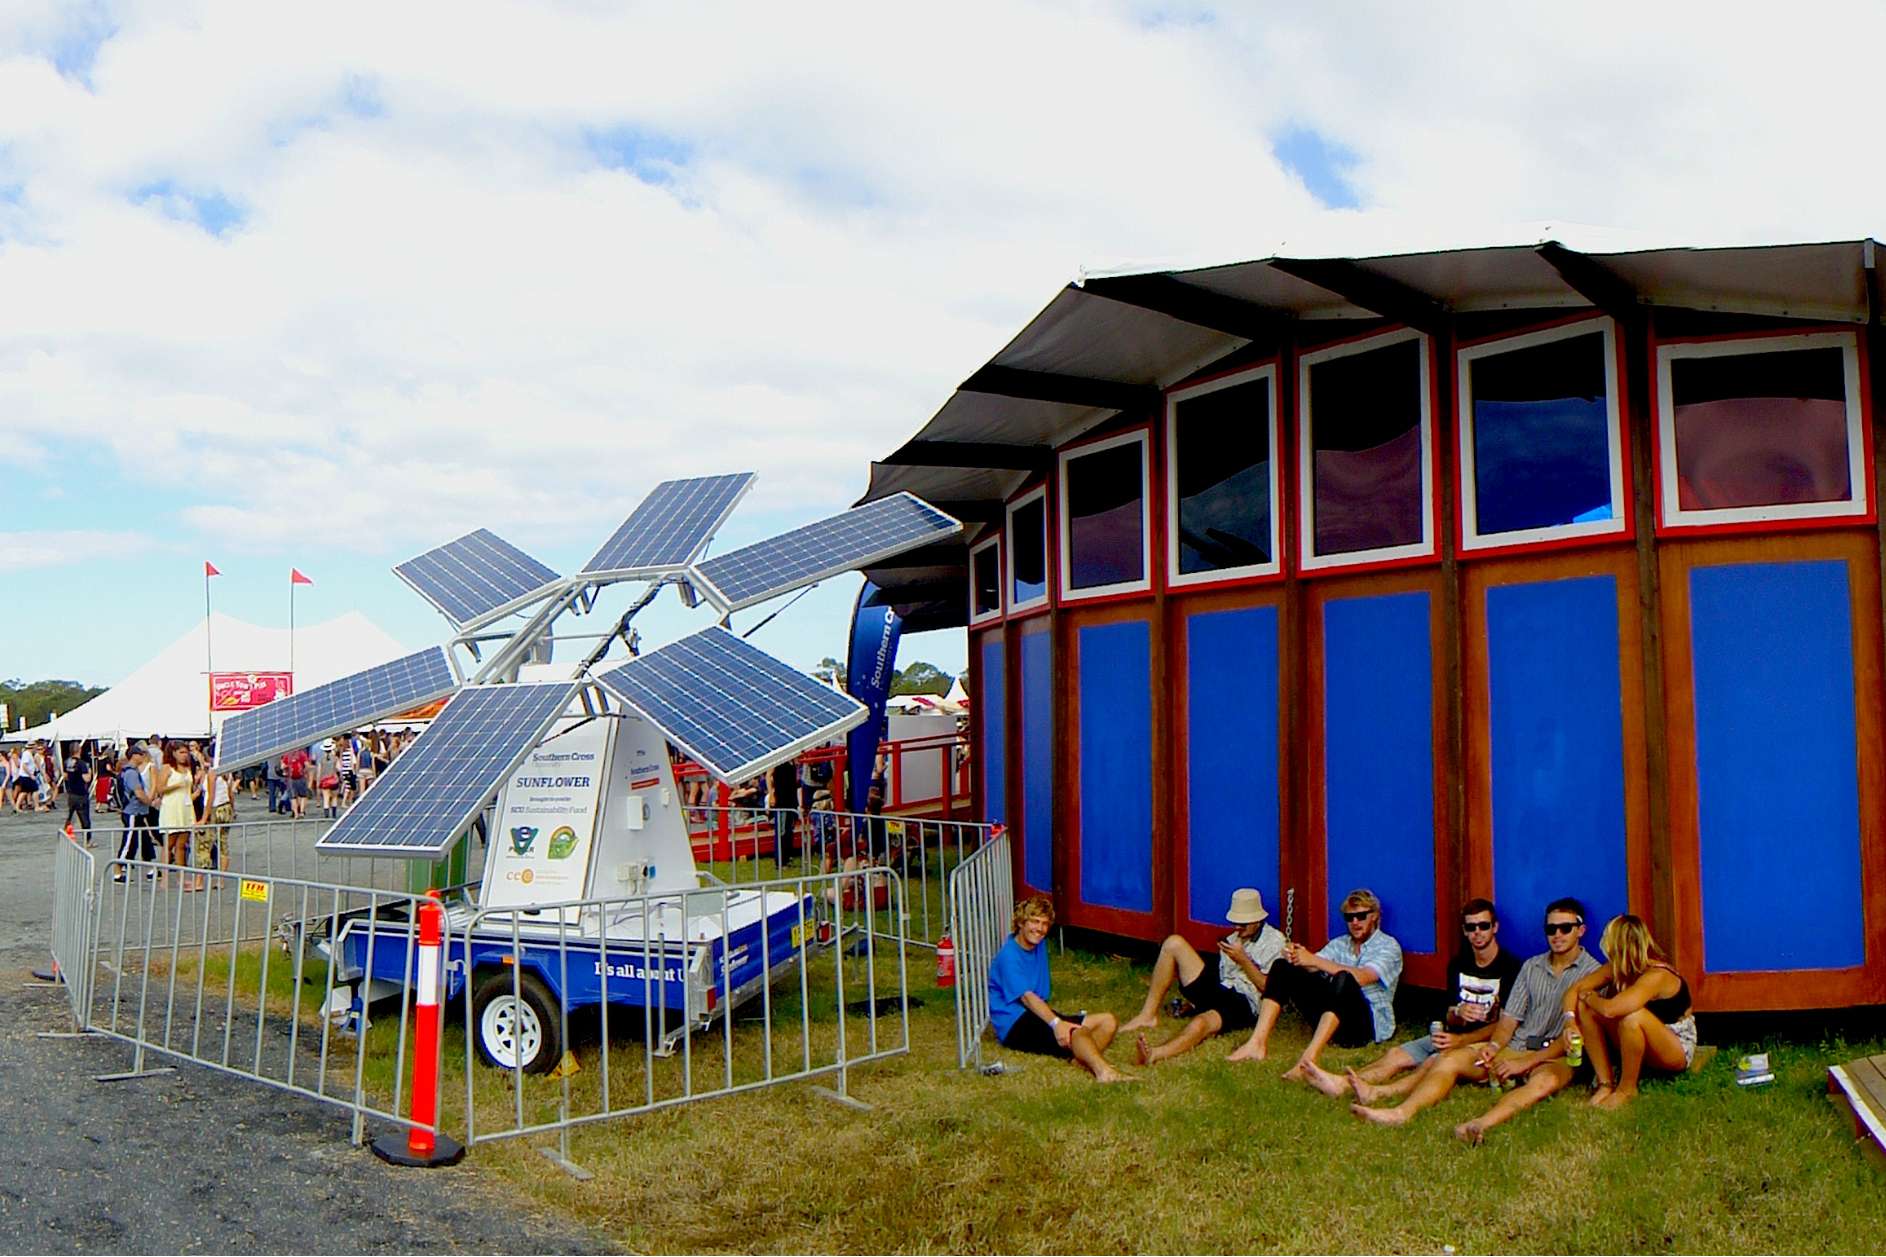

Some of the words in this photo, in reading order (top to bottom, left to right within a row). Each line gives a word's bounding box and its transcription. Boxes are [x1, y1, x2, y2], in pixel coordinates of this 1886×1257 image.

[871, 624, 892, 689] Southern
[533, 753, 570, 761] Southern
[571, 752, 595, 761] Cross
[516, 776, 590, 788] SUNFLOWER
[616, 964, 635, 979] all
